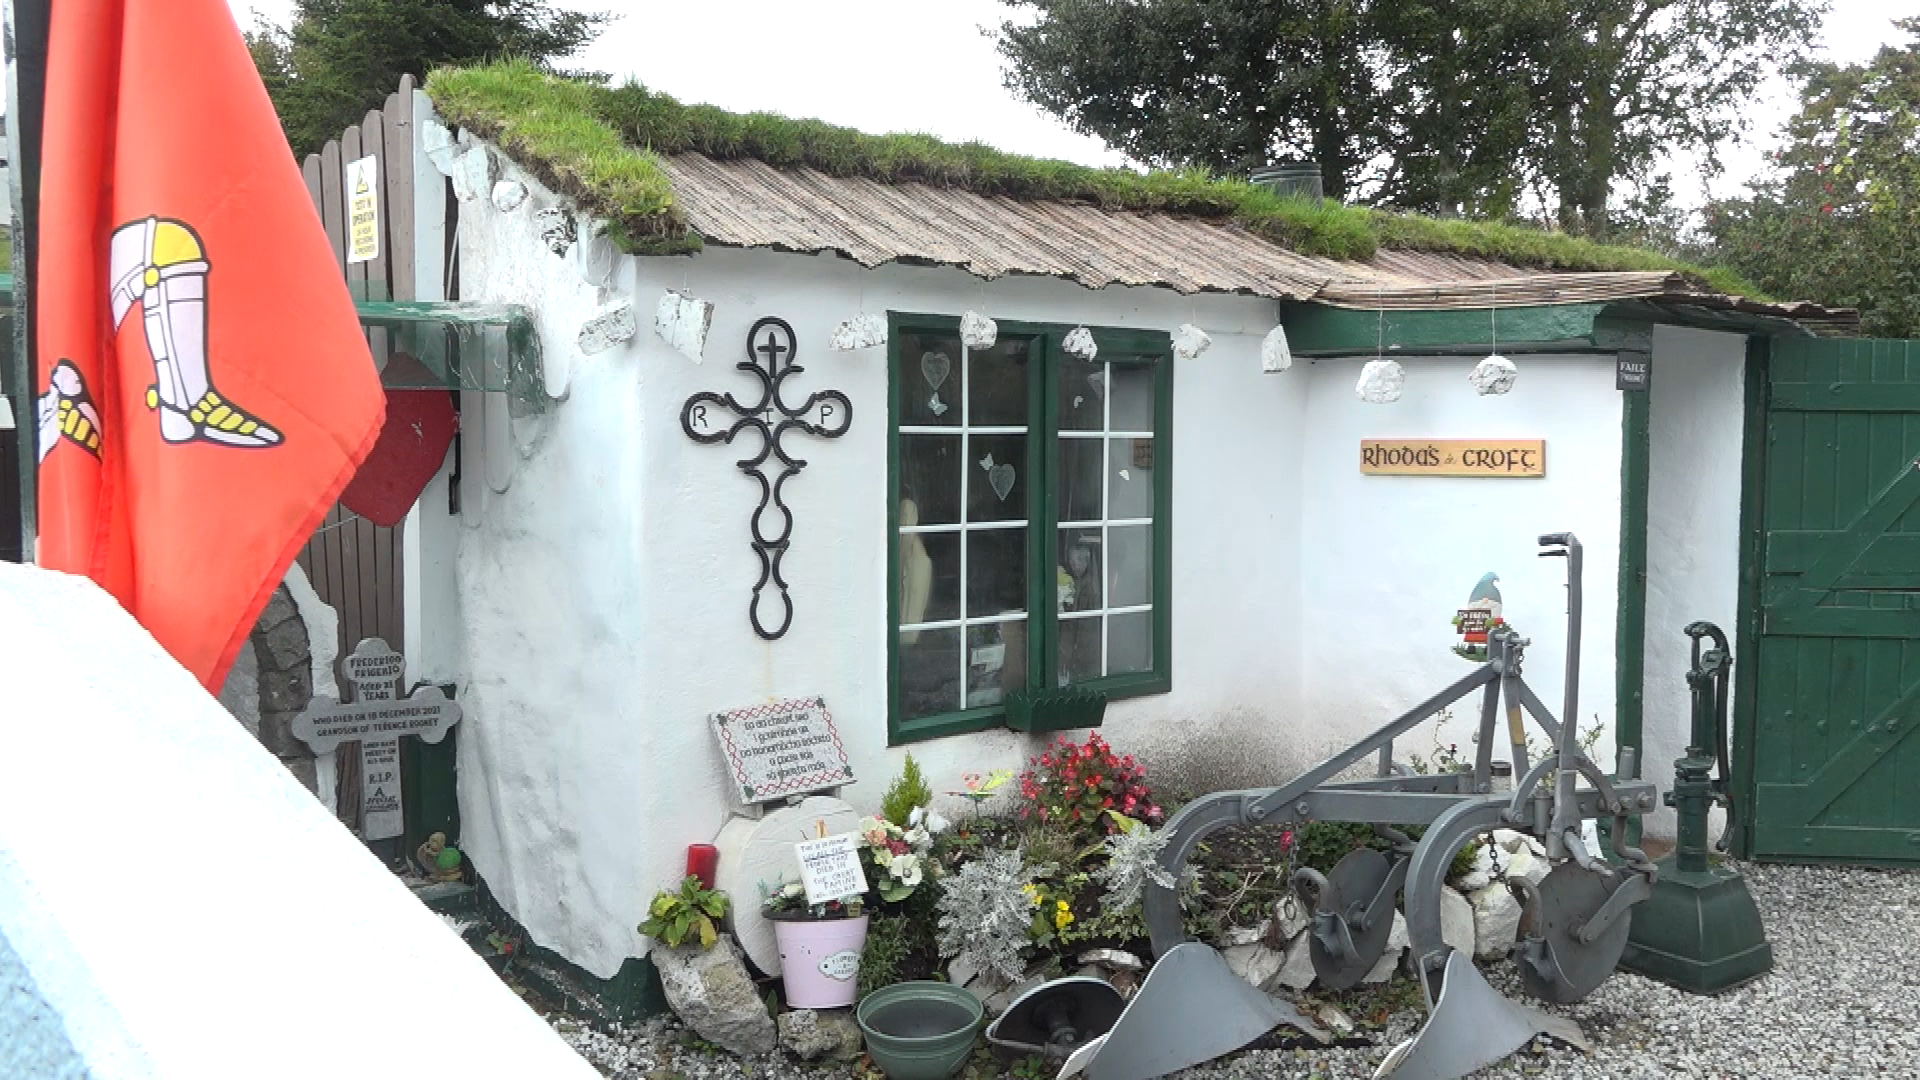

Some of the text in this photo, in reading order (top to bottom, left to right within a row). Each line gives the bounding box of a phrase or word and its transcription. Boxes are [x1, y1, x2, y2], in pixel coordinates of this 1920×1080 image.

[693, 405, 708, 428] R
[820, 404, 834, 425] P
[1462, 449, 1537, 471] CROFT
[312, 715, 332, 725] WHO
[333, 714, 353, 723] DIED
[355, 712, 366, 721] ON
[379, 707, 421, 719] DECEMBER
[423, 705, 440, 715] 2021
[316, 726, 358, 737] GRANDSON
[360, 725, 370, 733] OF
[373, 721, 407, 732] TERENCE
[374, 785, 385, 797] A
